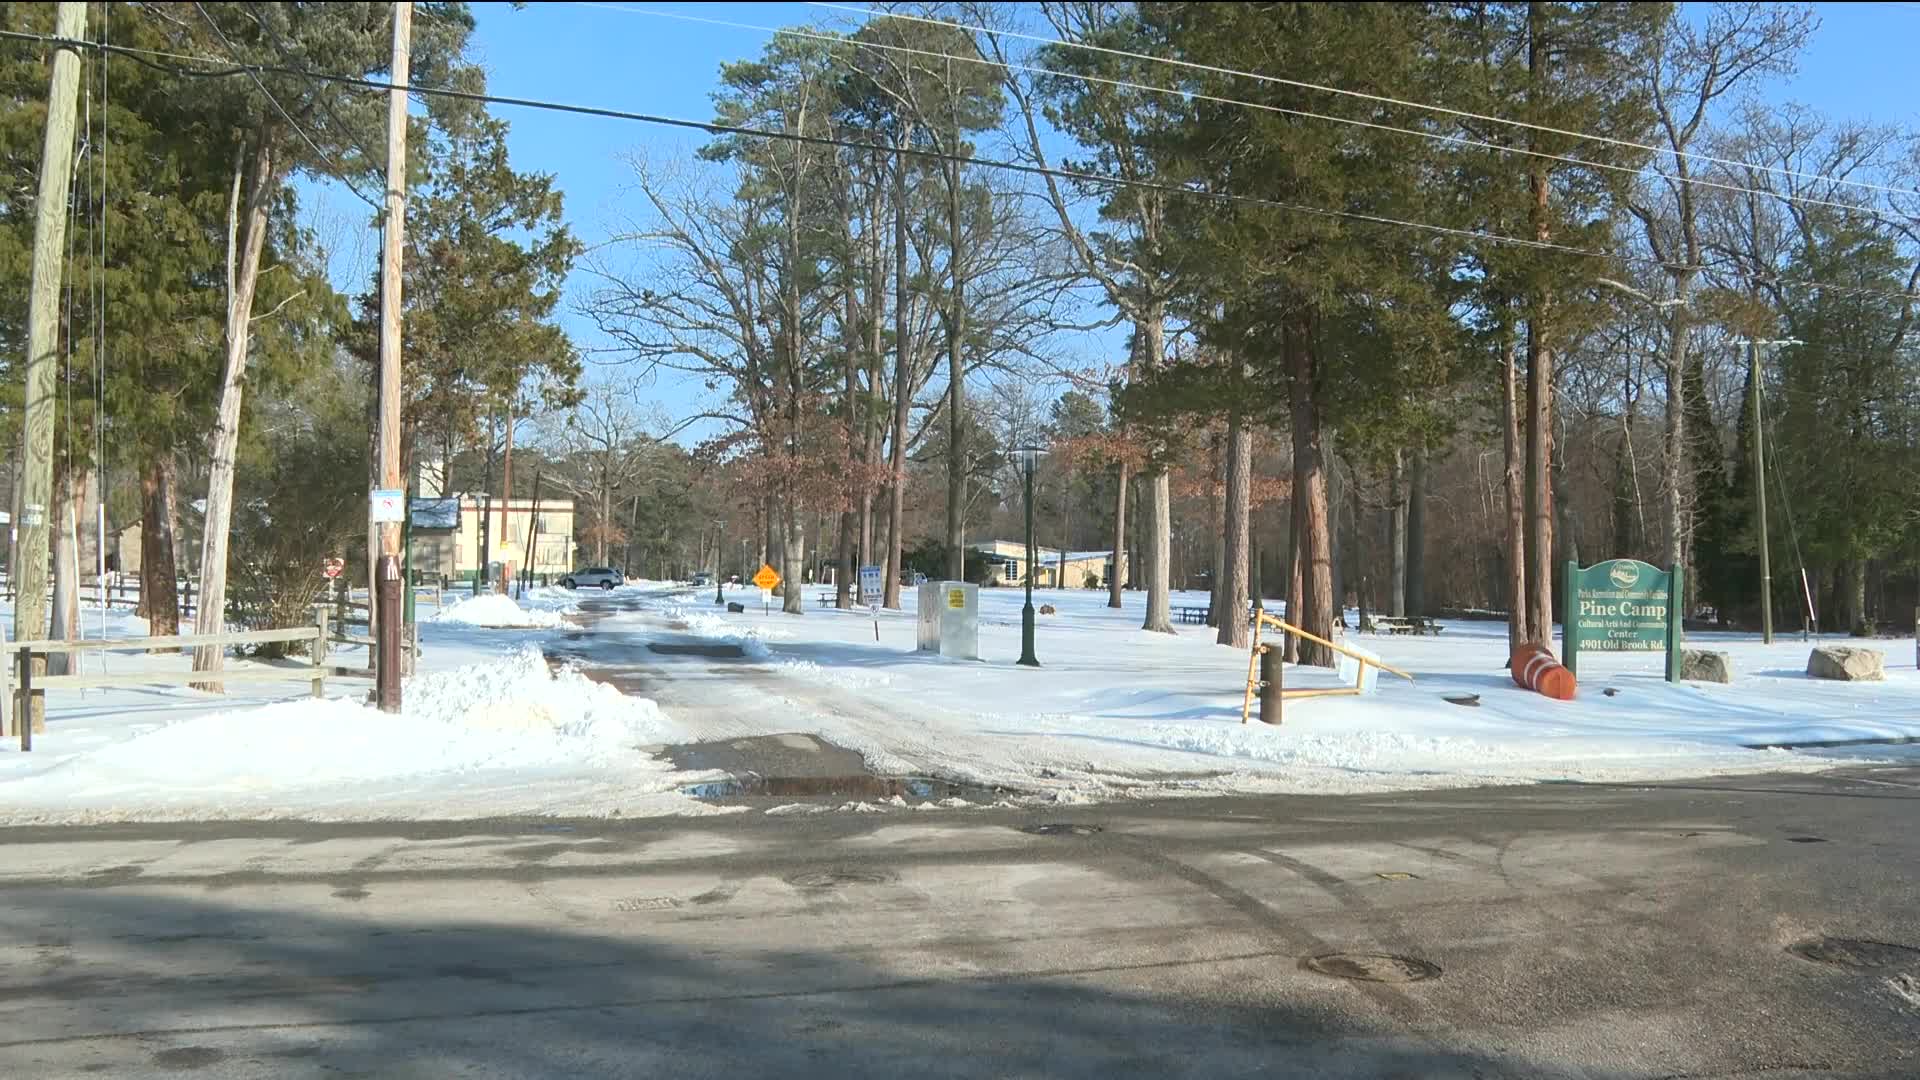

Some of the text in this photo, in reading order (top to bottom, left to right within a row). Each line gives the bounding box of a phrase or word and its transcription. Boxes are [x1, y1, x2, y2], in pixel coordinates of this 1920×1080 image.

[1580, 600, 1667, 620] Pine Camp
[1578, 620, 1604, 629] Cultural
[1605, 620, 1618, 628] Arts
[1608, 629, 1639, 639] Center
[1580, 640, 1665, 650] 4901 Old Brook Rd.
